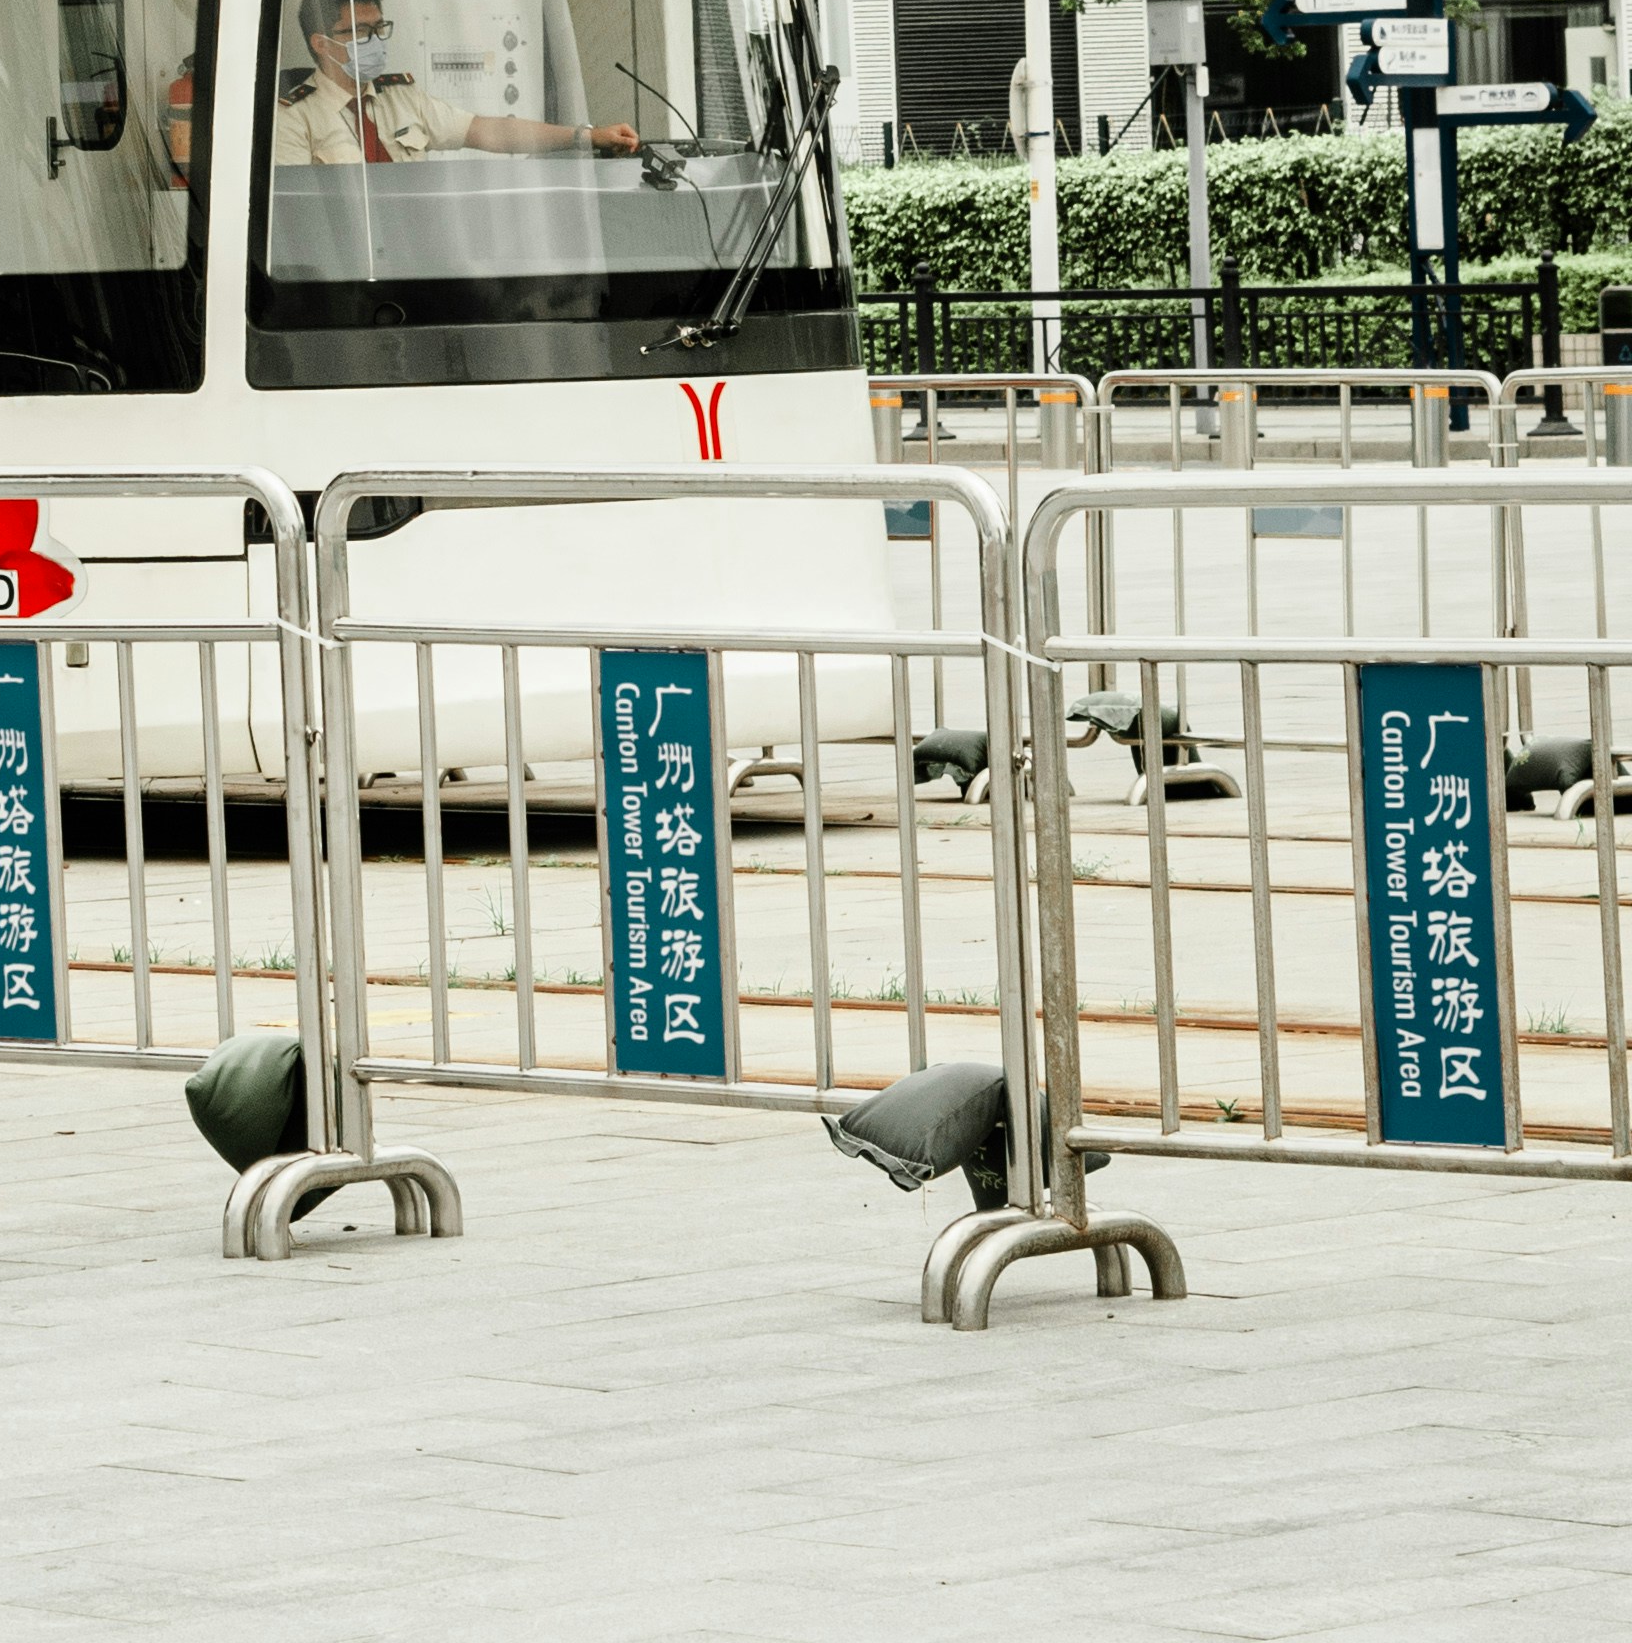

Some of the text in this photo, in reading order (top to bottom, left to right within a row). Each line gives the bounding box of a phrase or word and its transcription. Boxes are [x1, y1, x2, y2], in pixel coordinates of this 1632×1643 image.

[615, 682, 653, 1041] Canton Tower Tourism Area
[648, 683, 706, 1044] 广州塔旅游区
[1381, 710, 1426, 1097] Canton Tower Tourism Area
[1420, 711, 1487, 1101] 广州塔旅游区
